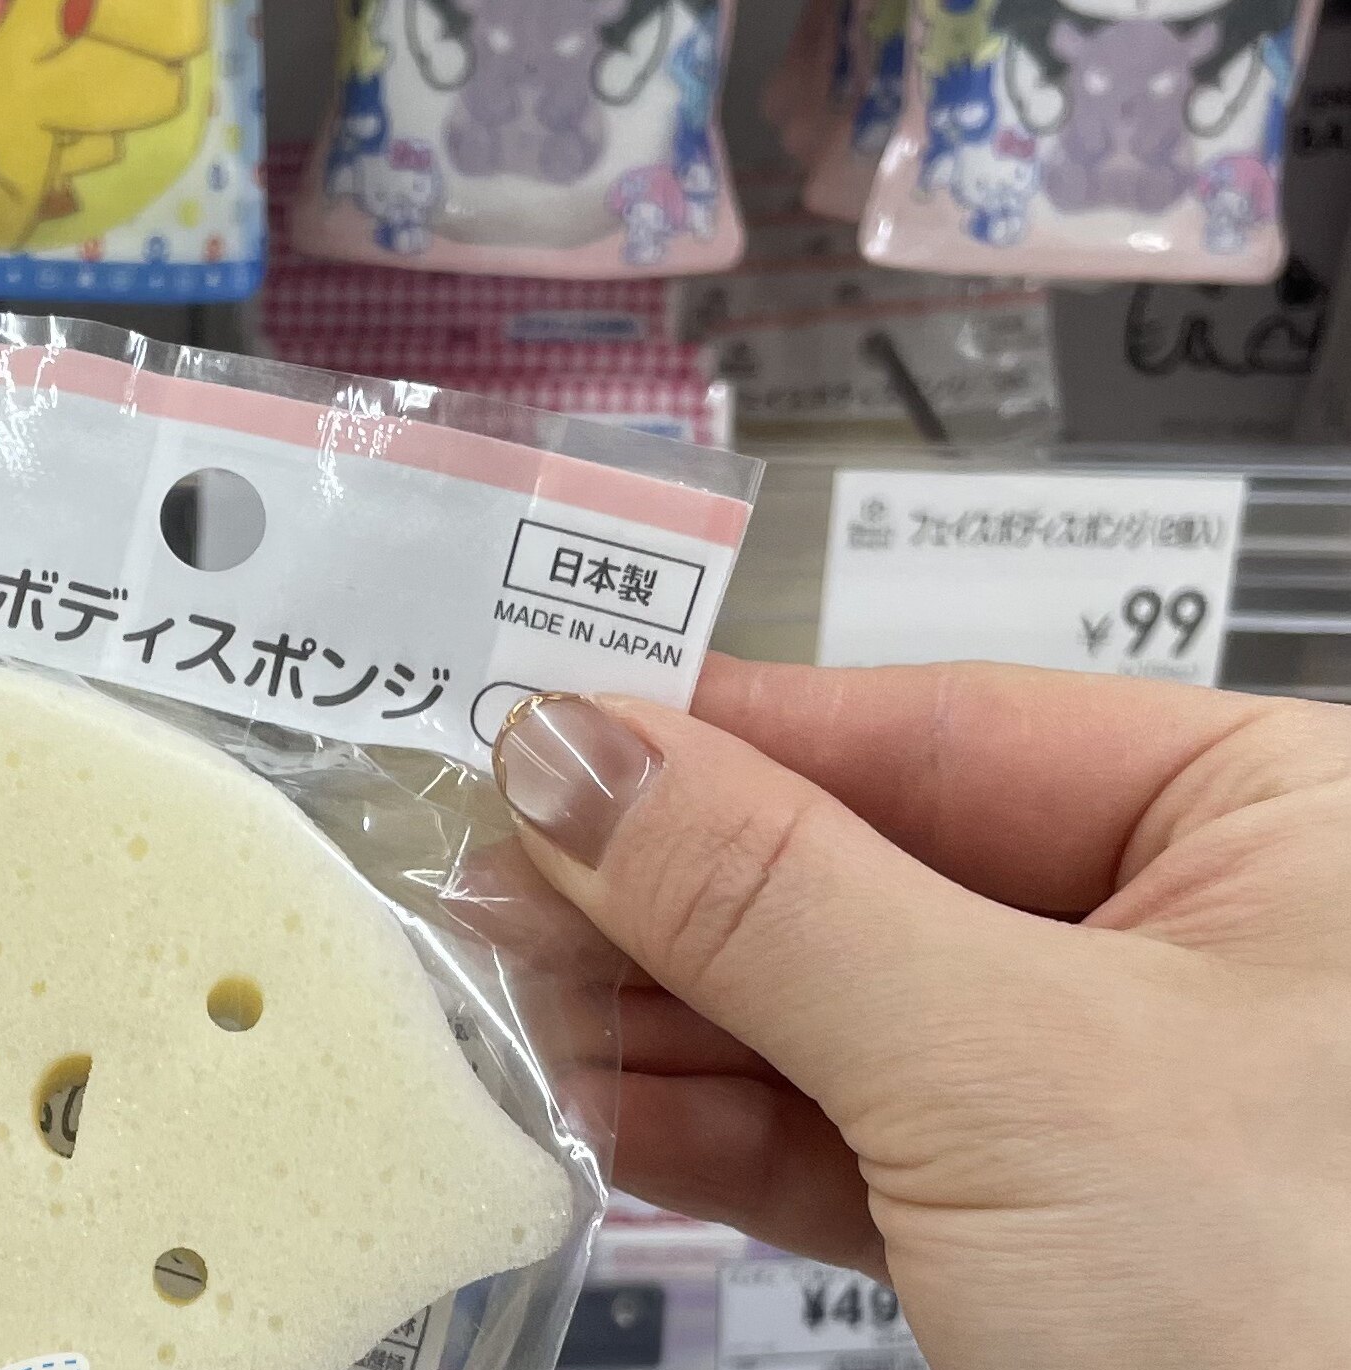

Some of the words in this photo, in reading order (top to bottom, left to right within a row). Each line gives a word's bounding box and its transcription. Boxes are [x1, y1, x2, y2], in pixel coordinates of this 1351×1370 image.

[550, 547, 657, 606] 日本製
[494, 600, 564, 635] MADE
[569, 618, 596, 644] IN
[600, 629, 683, 668] JAPAN
[1078, 585, 1209, 658] ¥99
[802, 1281, 898, 1331] ¥49
